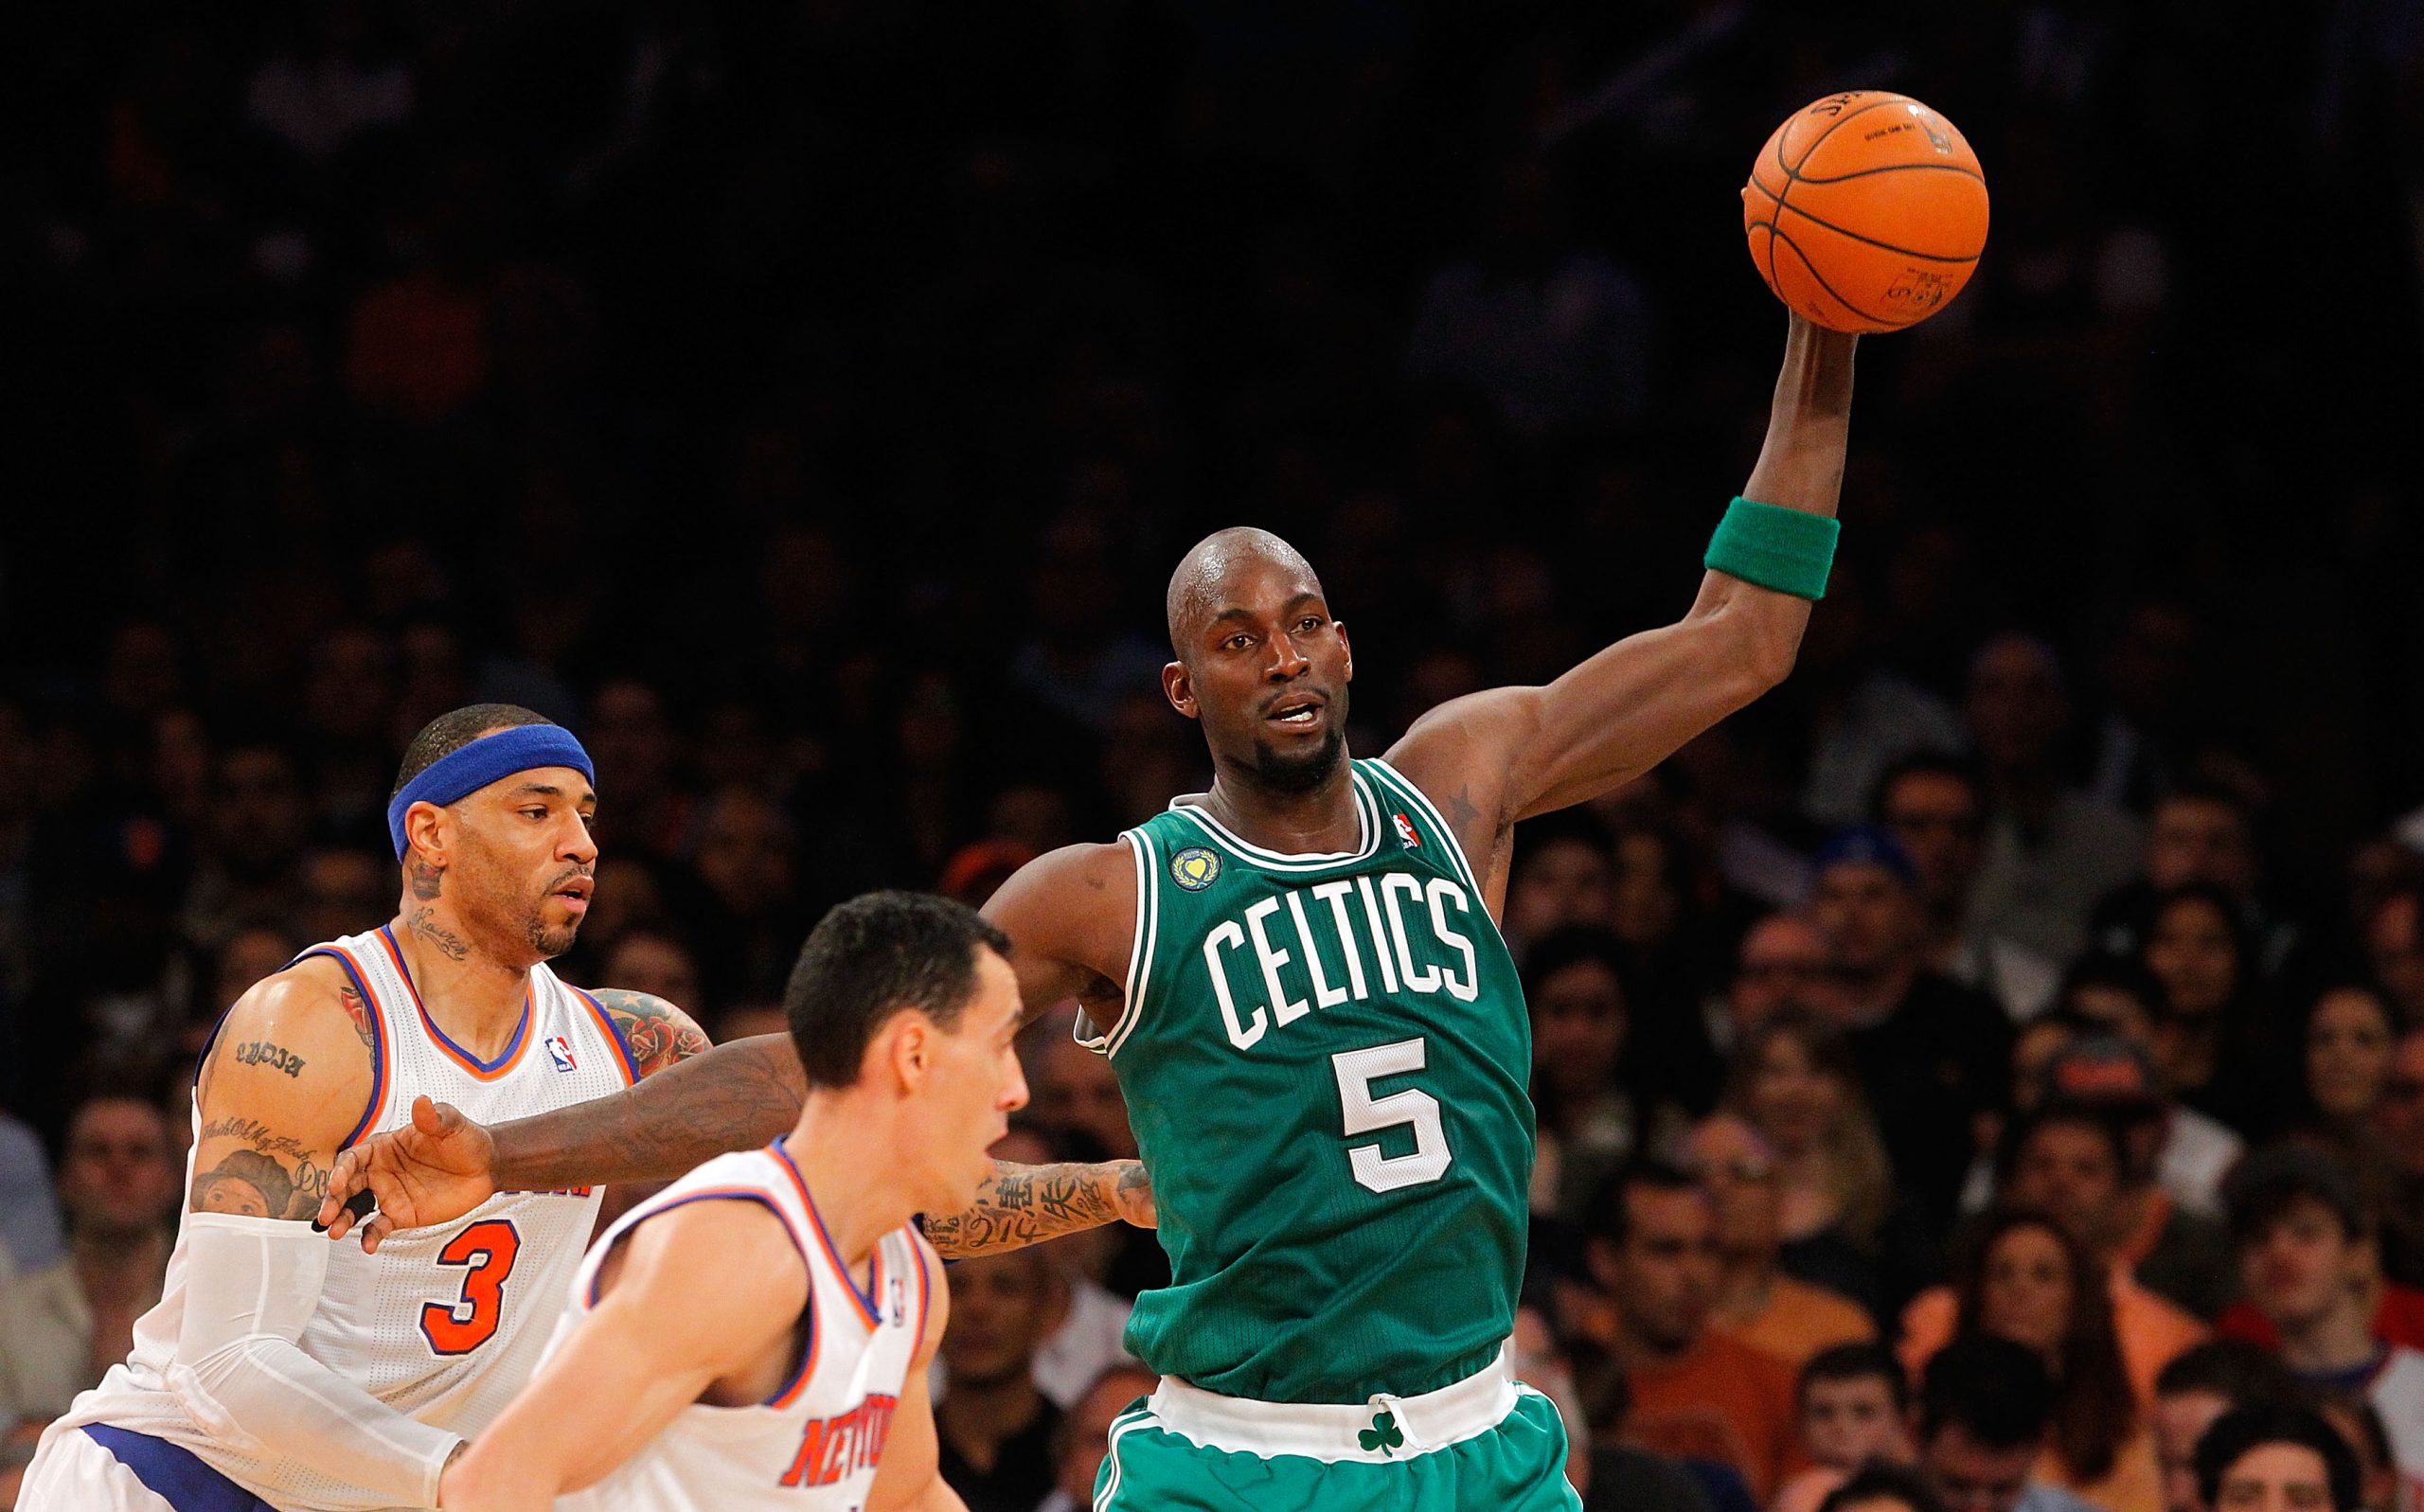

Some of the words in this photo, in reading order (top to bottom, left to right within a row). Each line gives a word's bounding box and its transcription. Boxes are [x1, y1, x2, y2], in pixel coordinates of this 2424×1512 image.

[1203, 871, 1479, 1051] CELTICS
[1331, 1038, 1453, 1194] 5
[420, 1219, 521, 1357] 3
[970, 1216, 1048, 1248] 214
